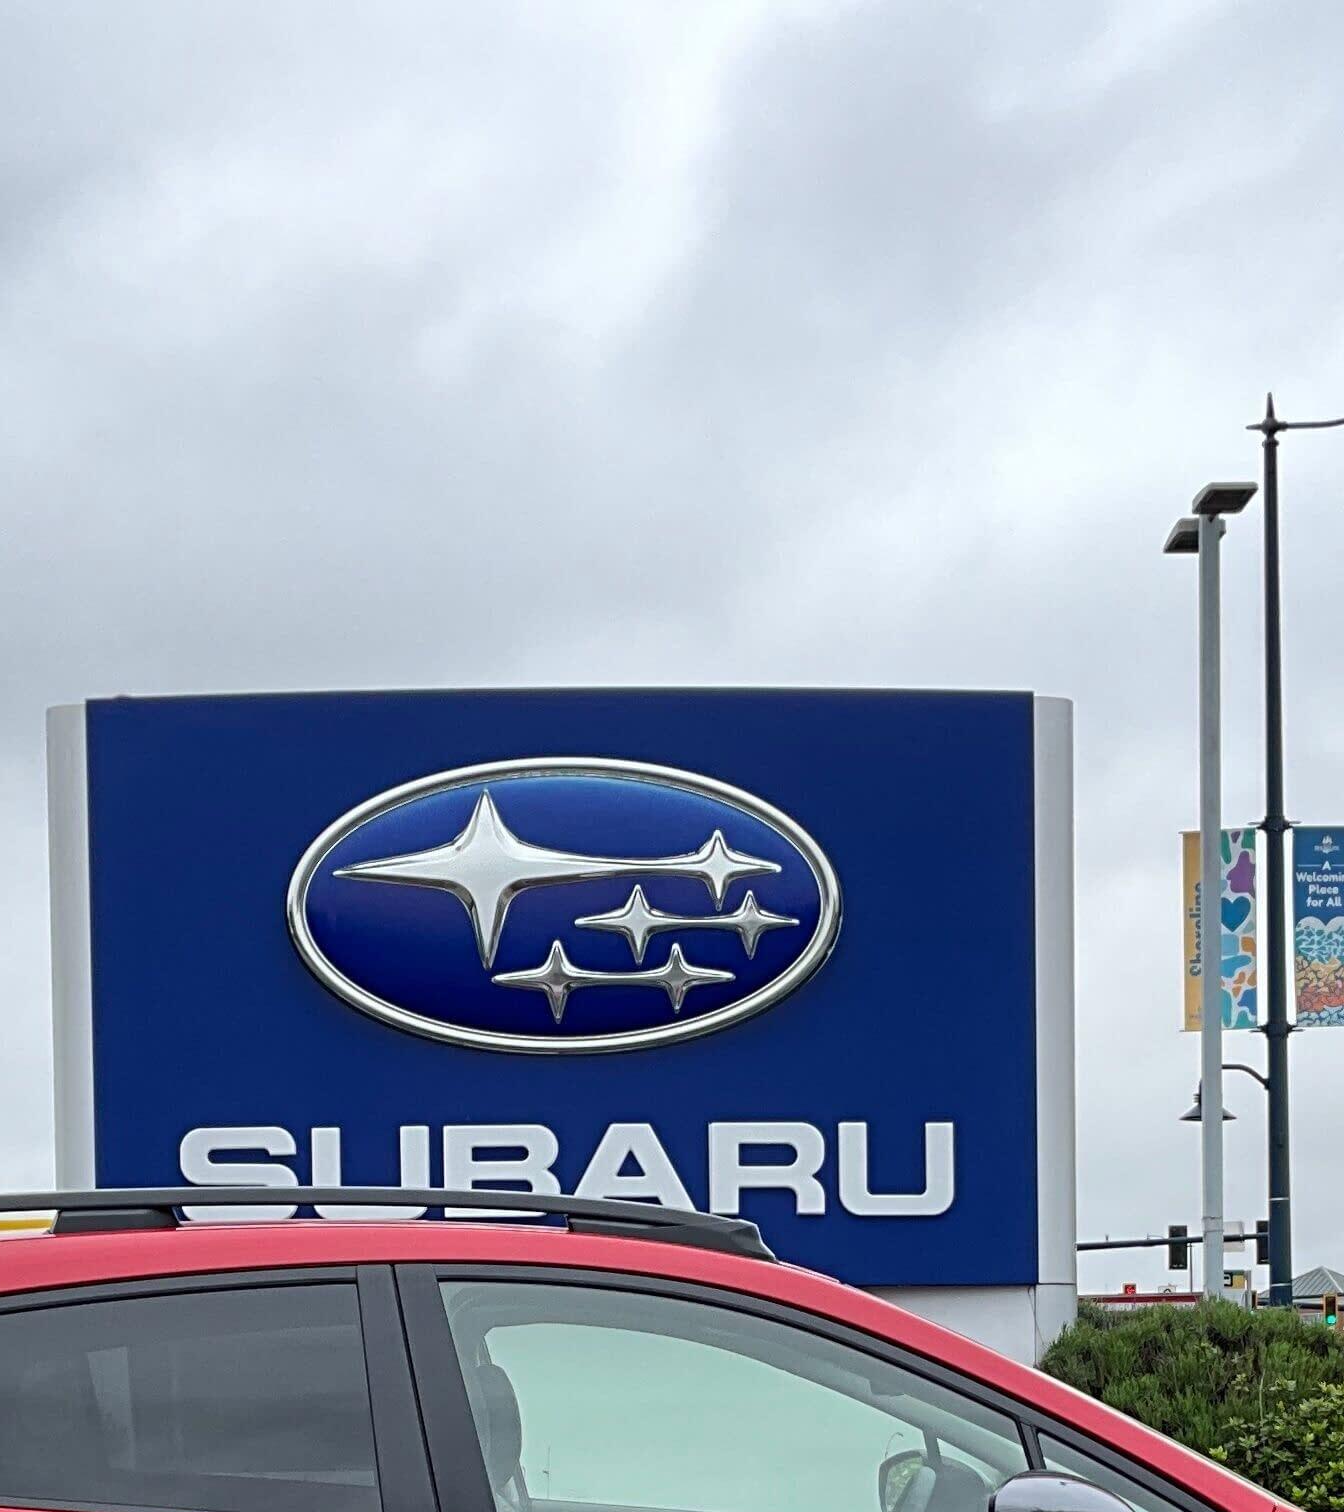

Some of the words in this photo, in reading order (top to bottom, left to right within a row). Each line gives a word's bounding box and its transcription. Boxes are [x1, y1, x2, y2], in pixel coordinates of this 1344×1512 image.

[1321, 861, 1331, 870] A
[1309, 885, 1339, 895] Place
[1306, 896, 1323, 907] for
[1326, 896, 1342, 907] All
[179, 1121, 954, 1222] SUBARU
